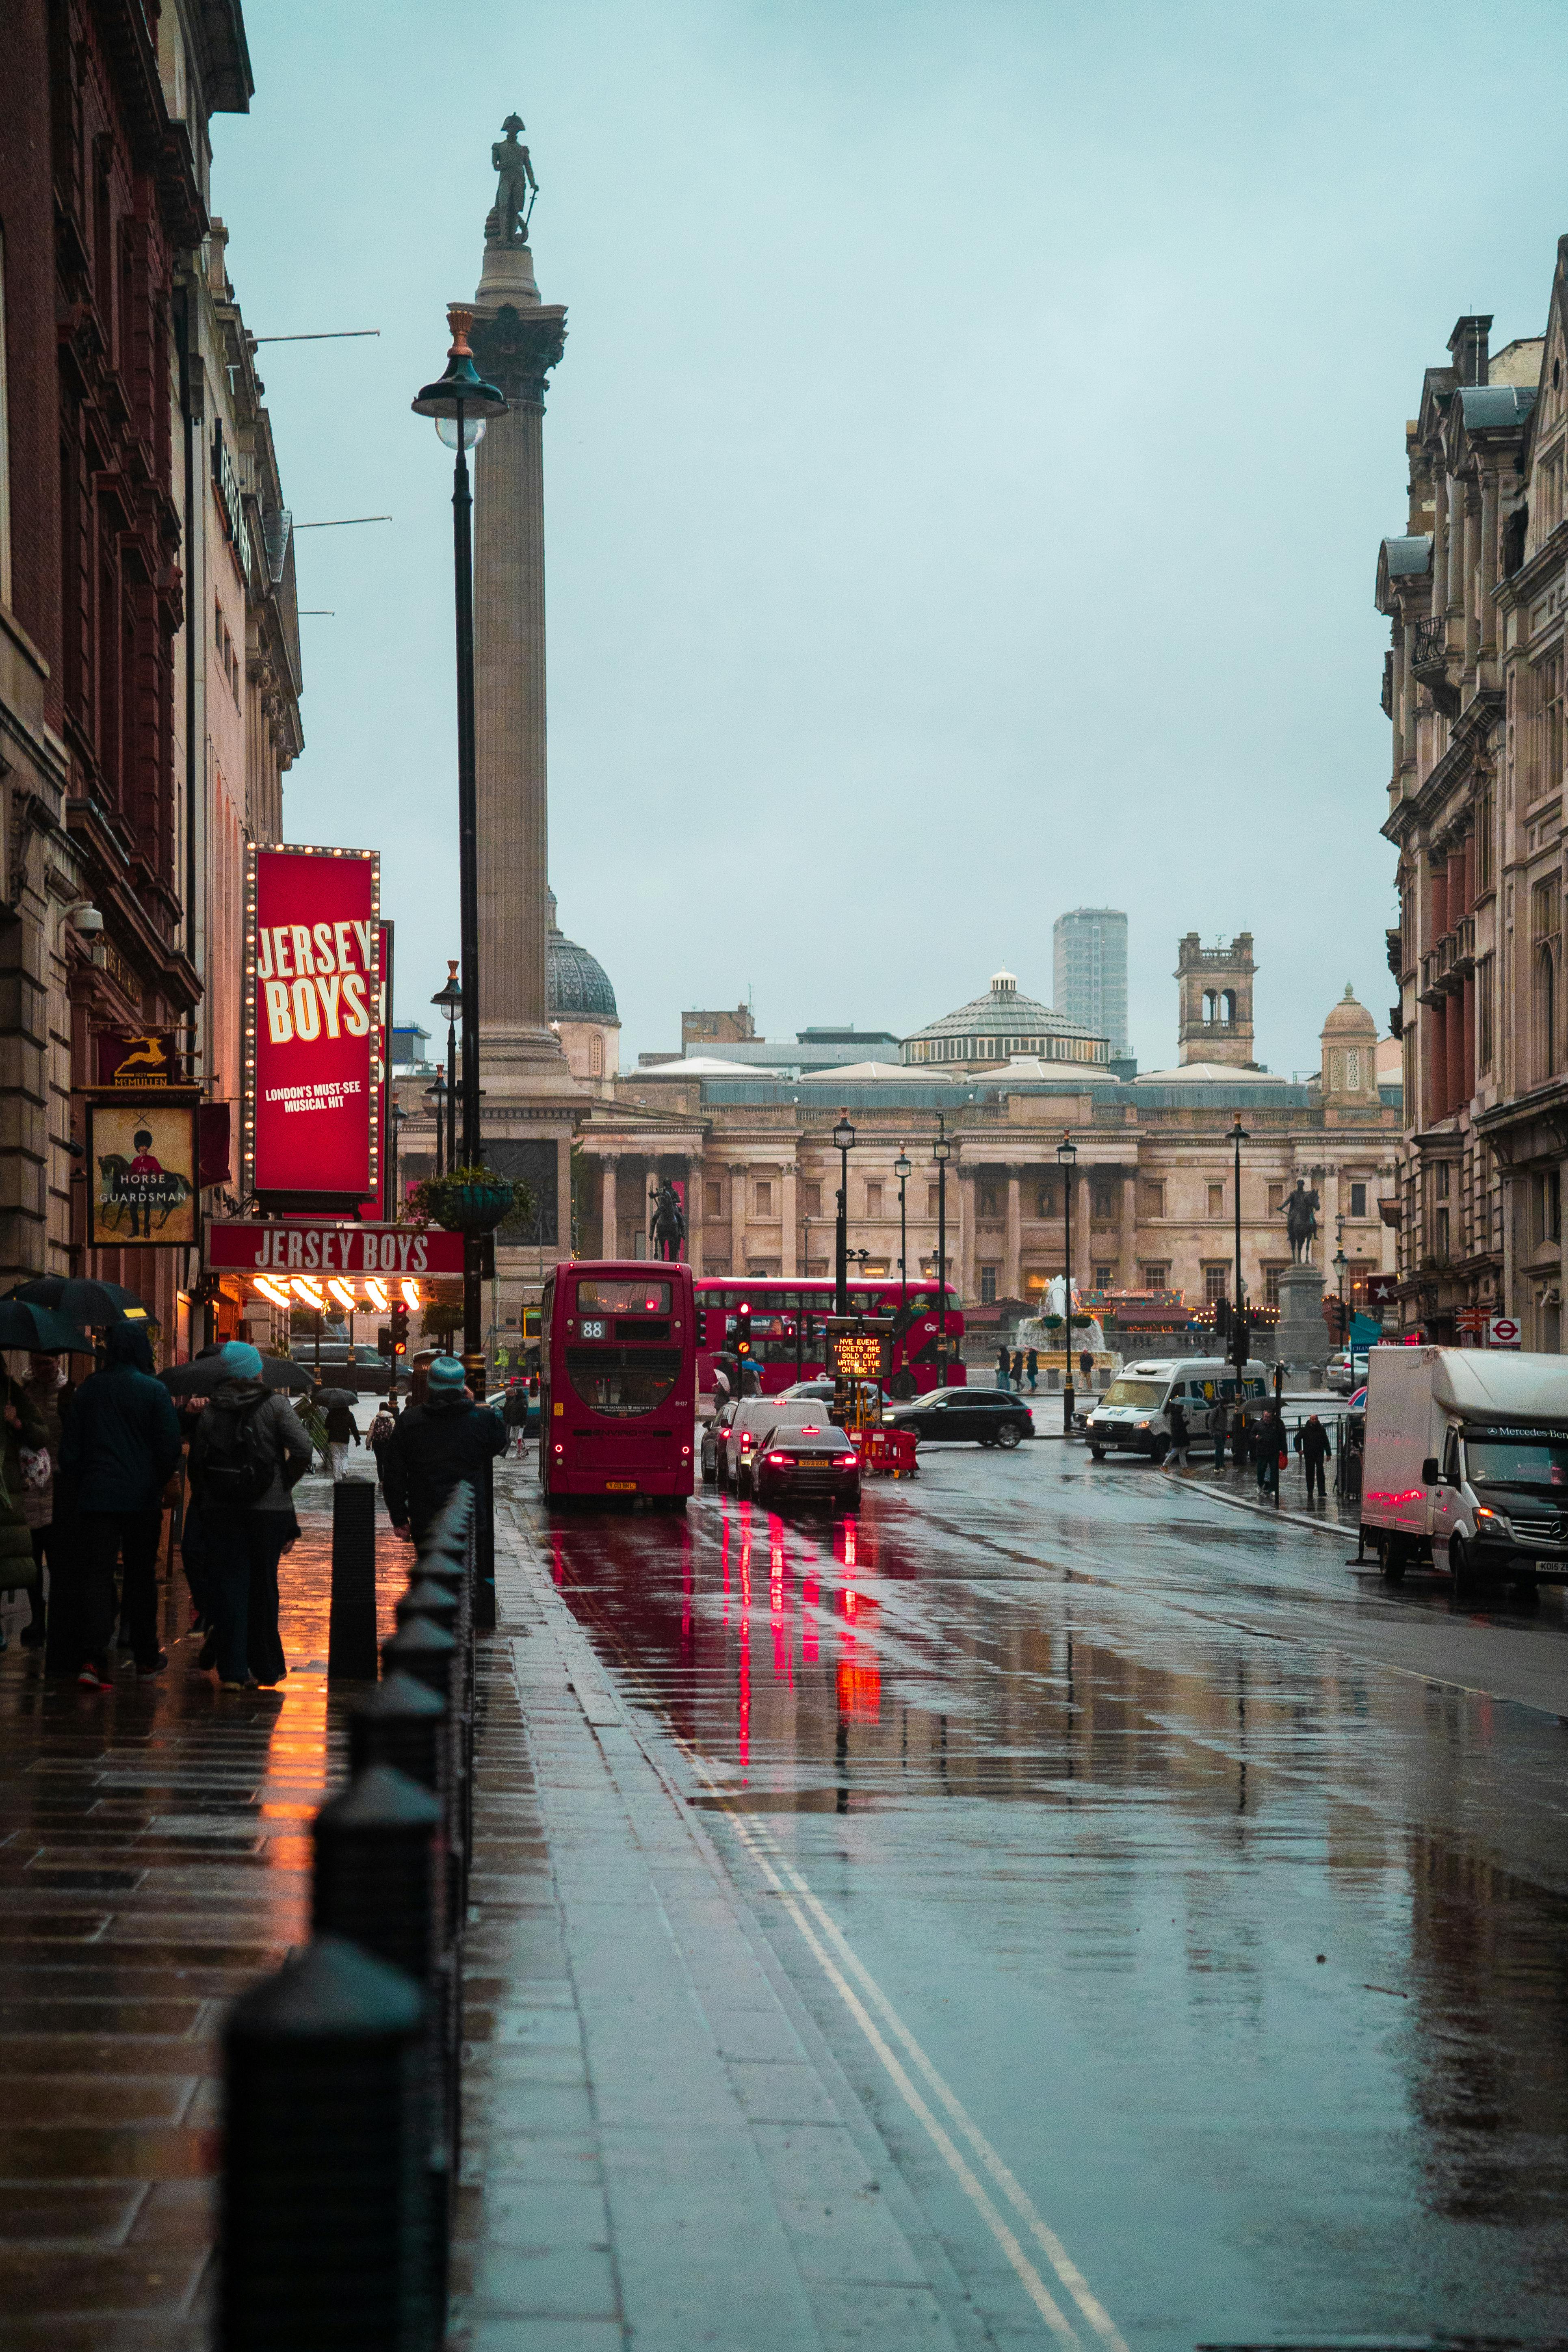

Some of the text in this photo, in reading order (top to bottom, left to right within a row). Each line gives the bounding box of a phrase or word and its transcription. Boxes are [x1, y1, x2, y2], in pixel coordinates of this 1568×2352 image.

[257, 920, 370, 979] JERSEY
[264, 973, 370, 1044] BOYS
[265, 1081, 361, 1102] LONDON'S MUST-SEE
[284, 1096, 344, 1113] MUSICAL HIT
[121, 1174, 165, 1184] HORSE
[100, 1192, 186, 1202] GUARDSMAN
[255, 1230, 428, 1271] JERSEY BOYS
[583, 1321, 602, 1337] 88
[1499, 1427, 1568, 1439] Mercedes-Ben
